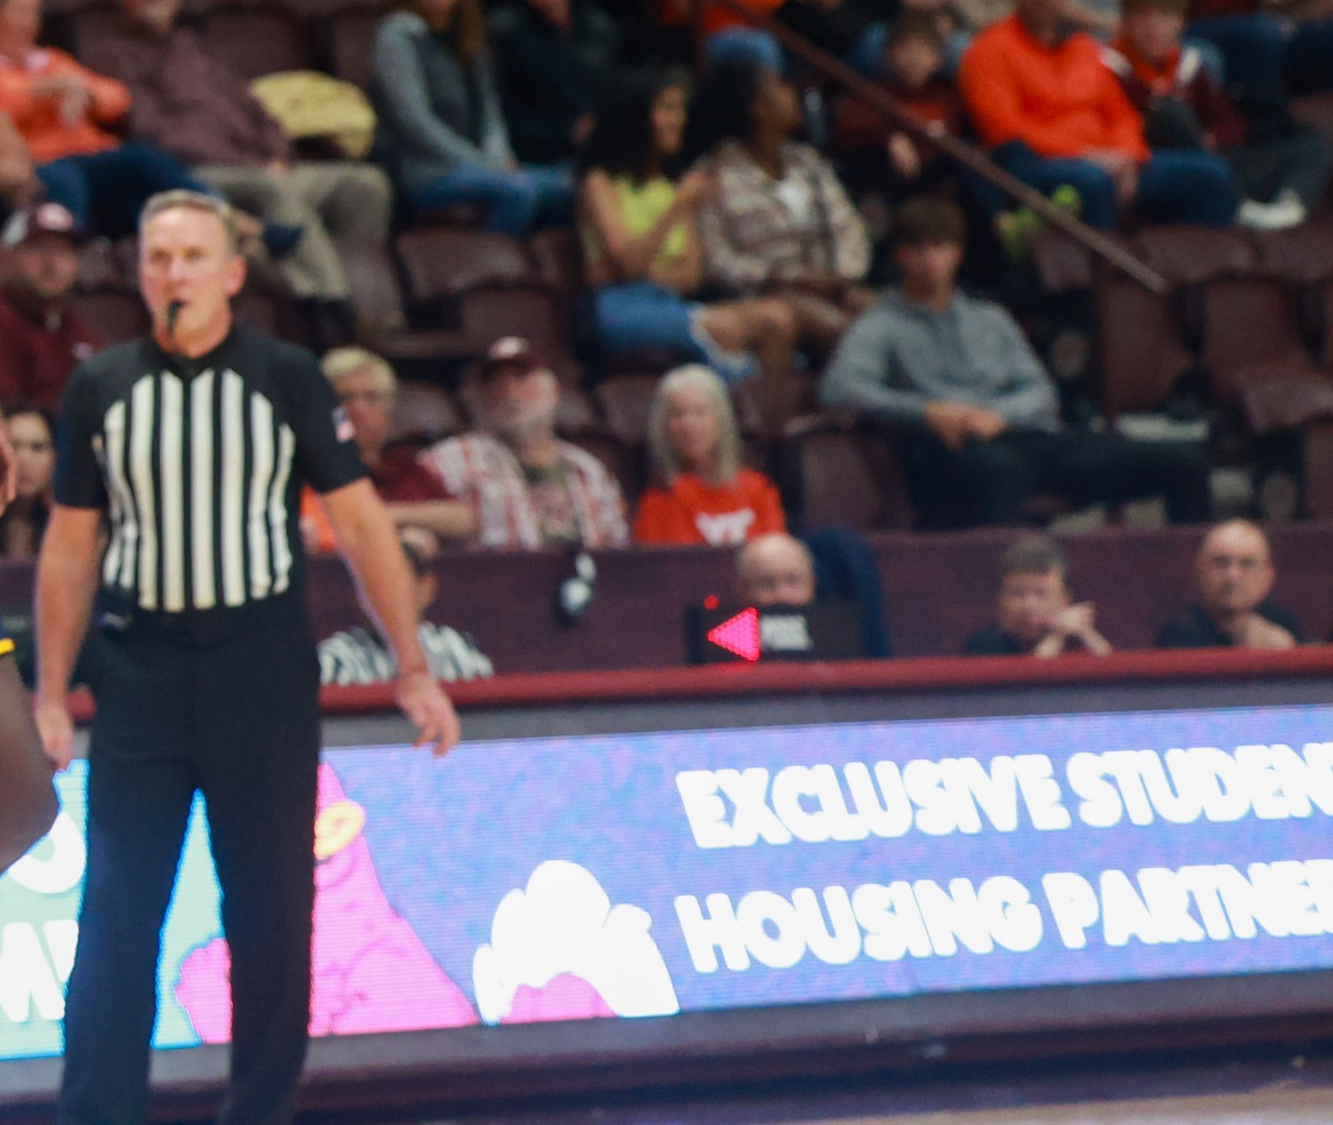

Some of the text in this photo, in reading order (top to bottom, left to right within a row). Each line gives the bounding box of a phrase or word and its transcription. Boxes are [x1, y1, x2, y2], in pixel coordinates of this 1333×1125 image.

[675, 741, 1333, 849] EXCLUSIVE STUDEN
[673, 875, 1044, 974] HOUSING
